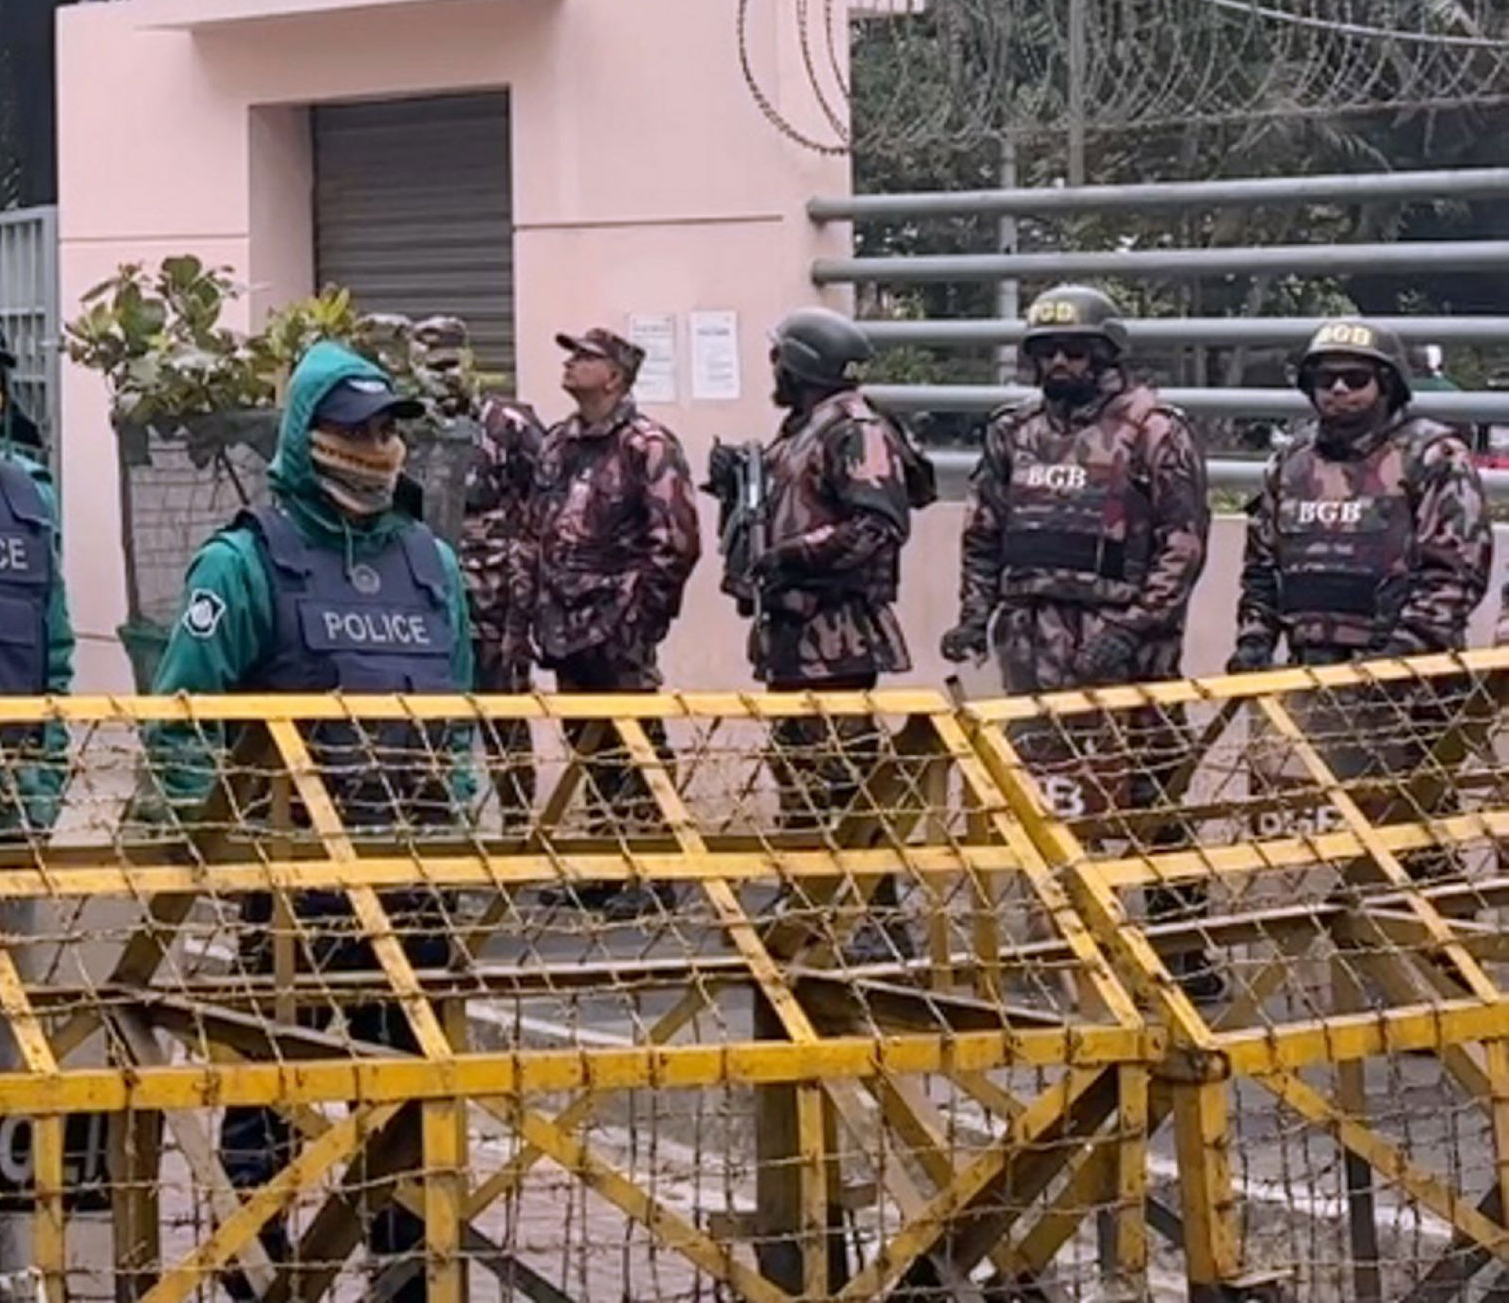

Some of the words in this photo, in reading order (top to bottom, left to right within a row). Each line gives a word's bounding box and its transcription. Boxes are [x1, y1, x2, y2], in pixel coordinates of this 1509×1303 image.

[1026, 465, 1088, 488] BGB
[1298, 501, 1361, 524] BGB
[324, 611, 431, 645] POLICE
